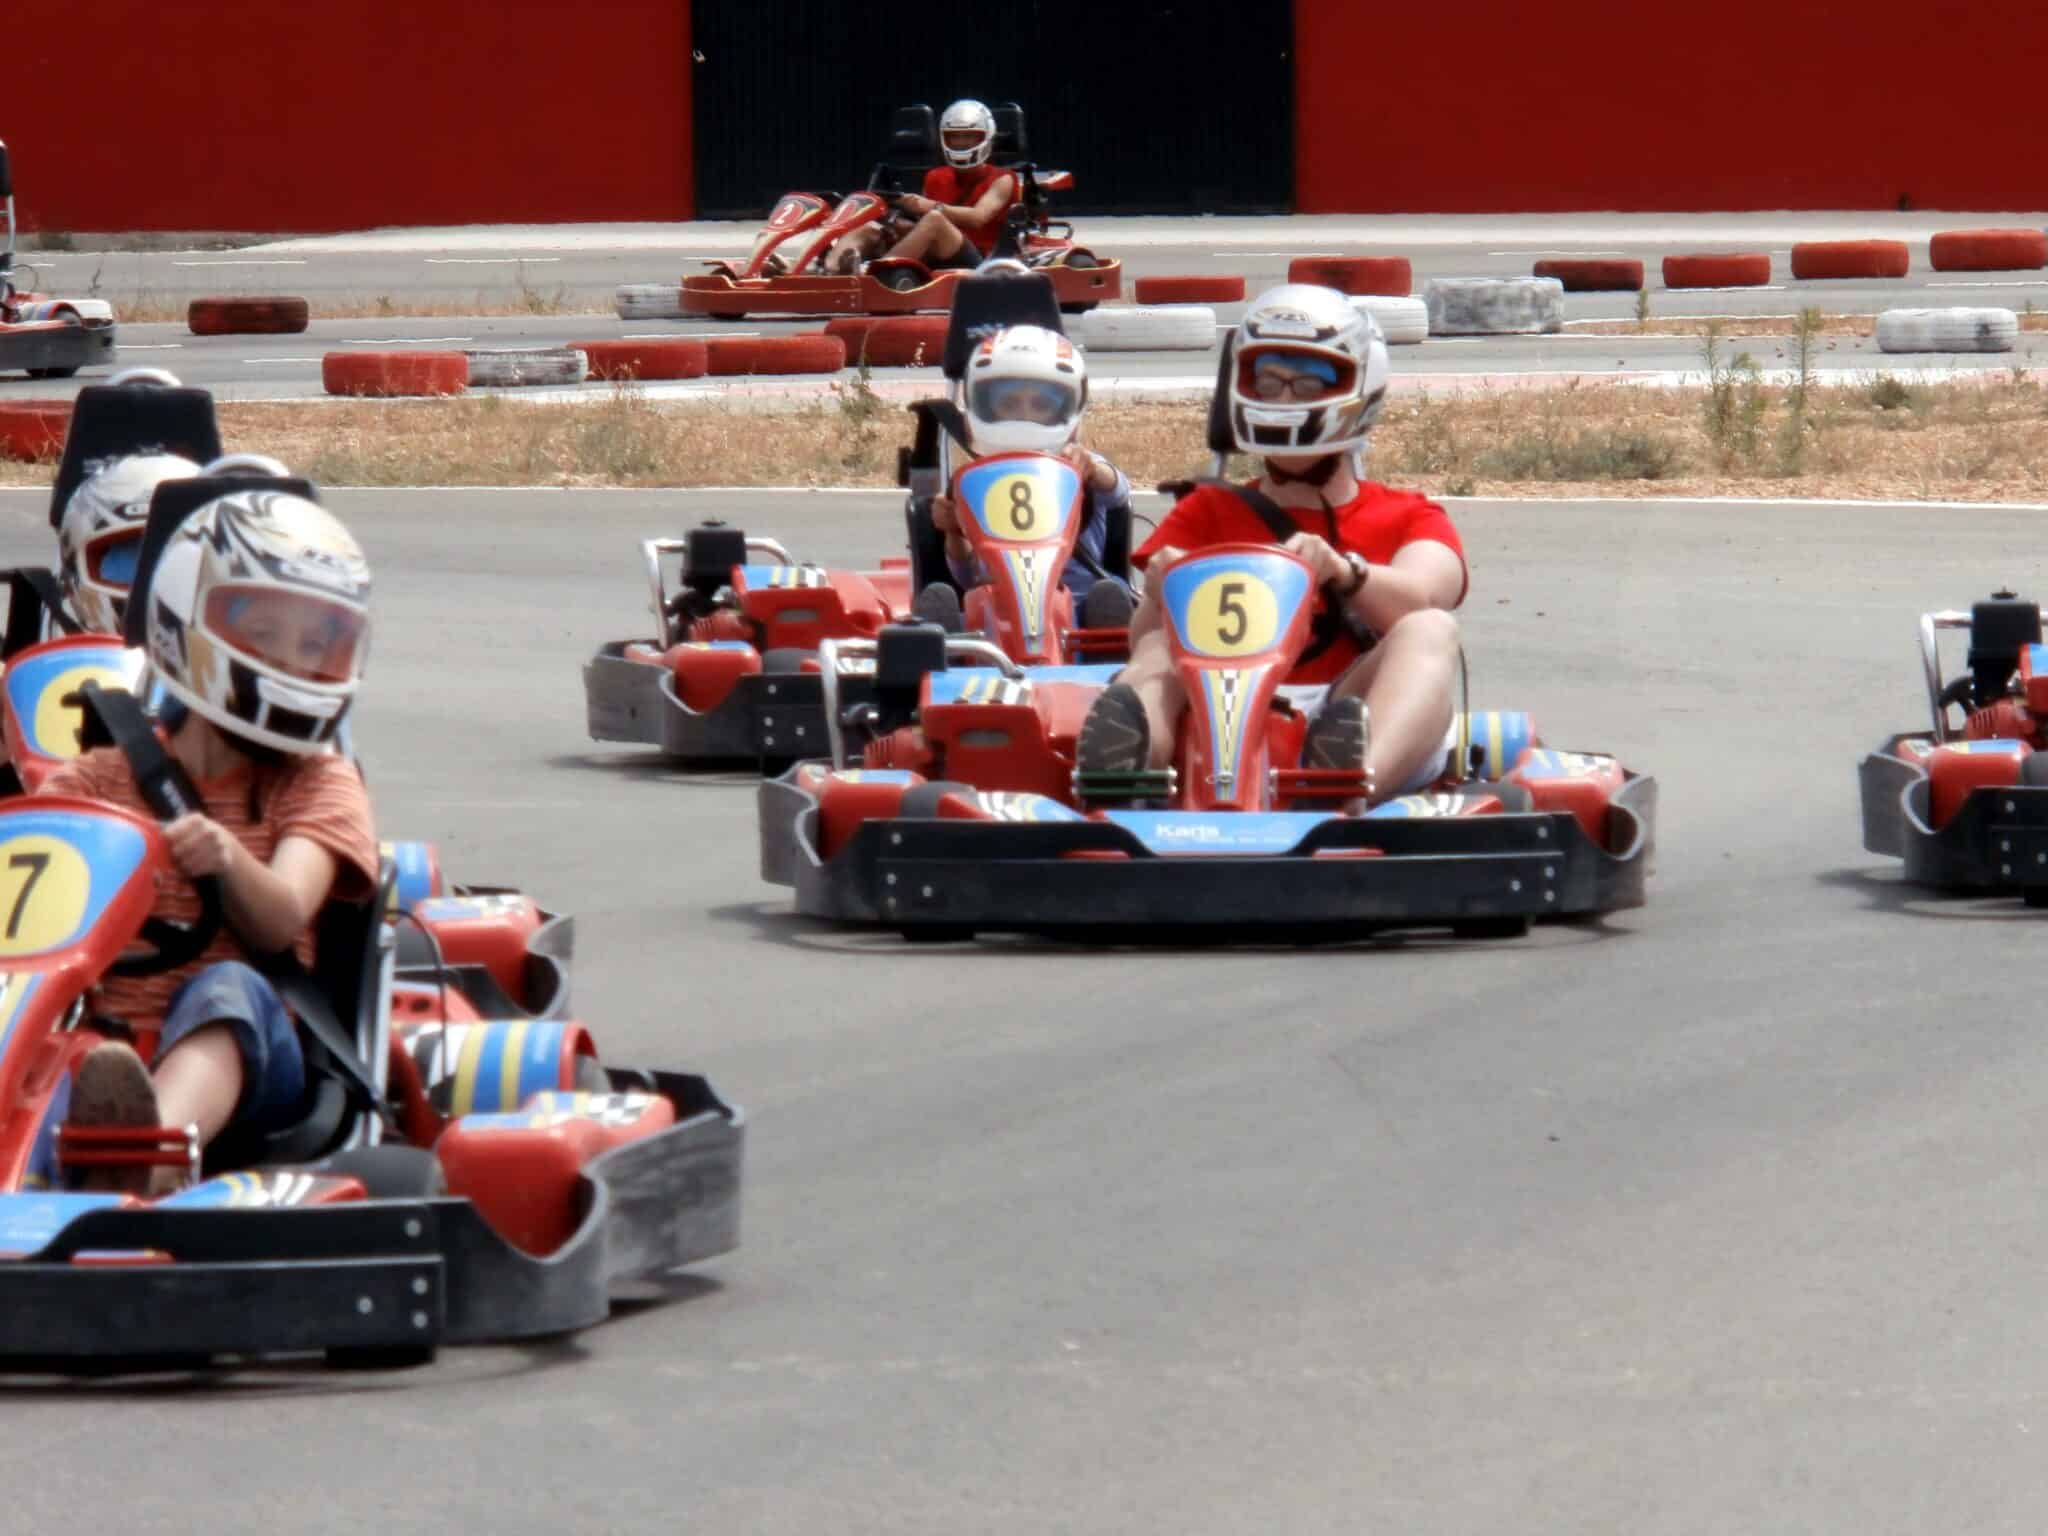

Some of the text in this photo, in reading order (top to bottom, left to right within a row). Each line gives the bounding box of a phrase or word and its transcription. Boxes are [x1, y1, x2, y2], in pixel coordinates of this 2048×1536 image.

[1009, 480, 1034, 531] 8
[1217, 583, 1248, 645] 5
[6, 852, 51, 939] 7
